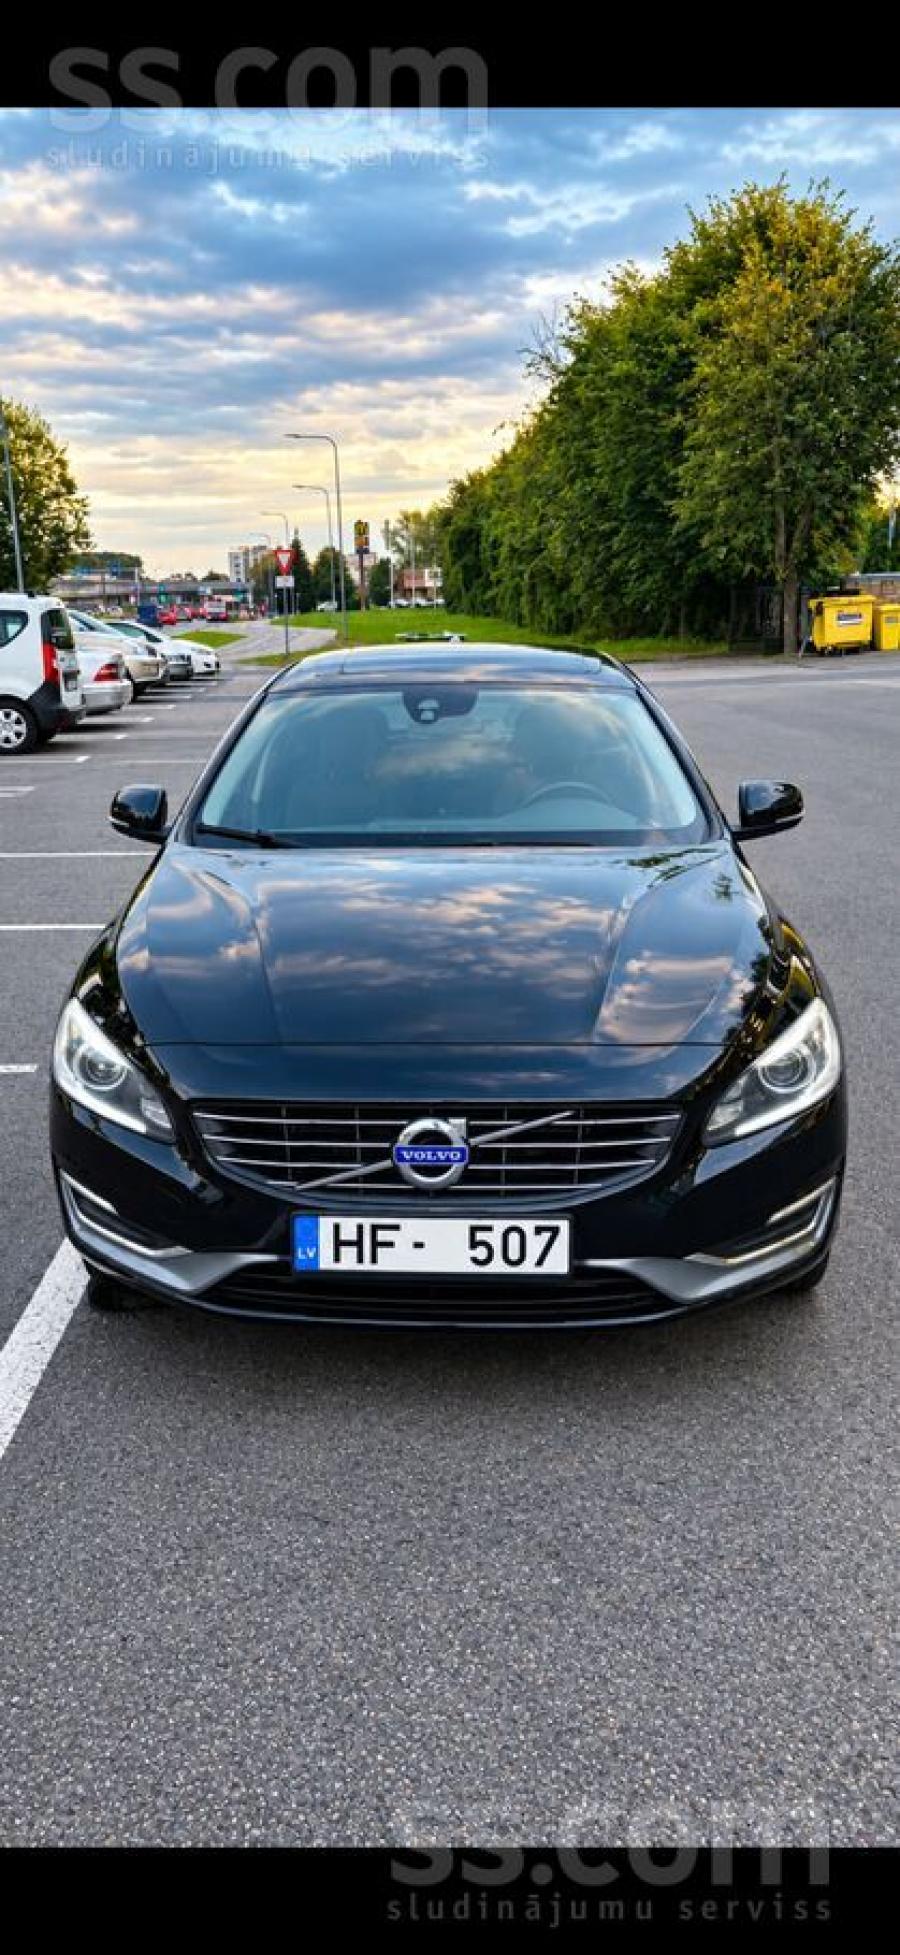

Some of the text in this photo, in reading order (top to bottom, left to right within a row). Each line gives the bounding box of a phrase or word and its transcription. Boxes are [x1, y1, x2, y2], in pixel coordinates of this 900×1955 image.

[400, 1150, 462, 1161] VOLVO
[467, 1225, 561, 1267] 507
[297, 1247, 317, 1259] LV
